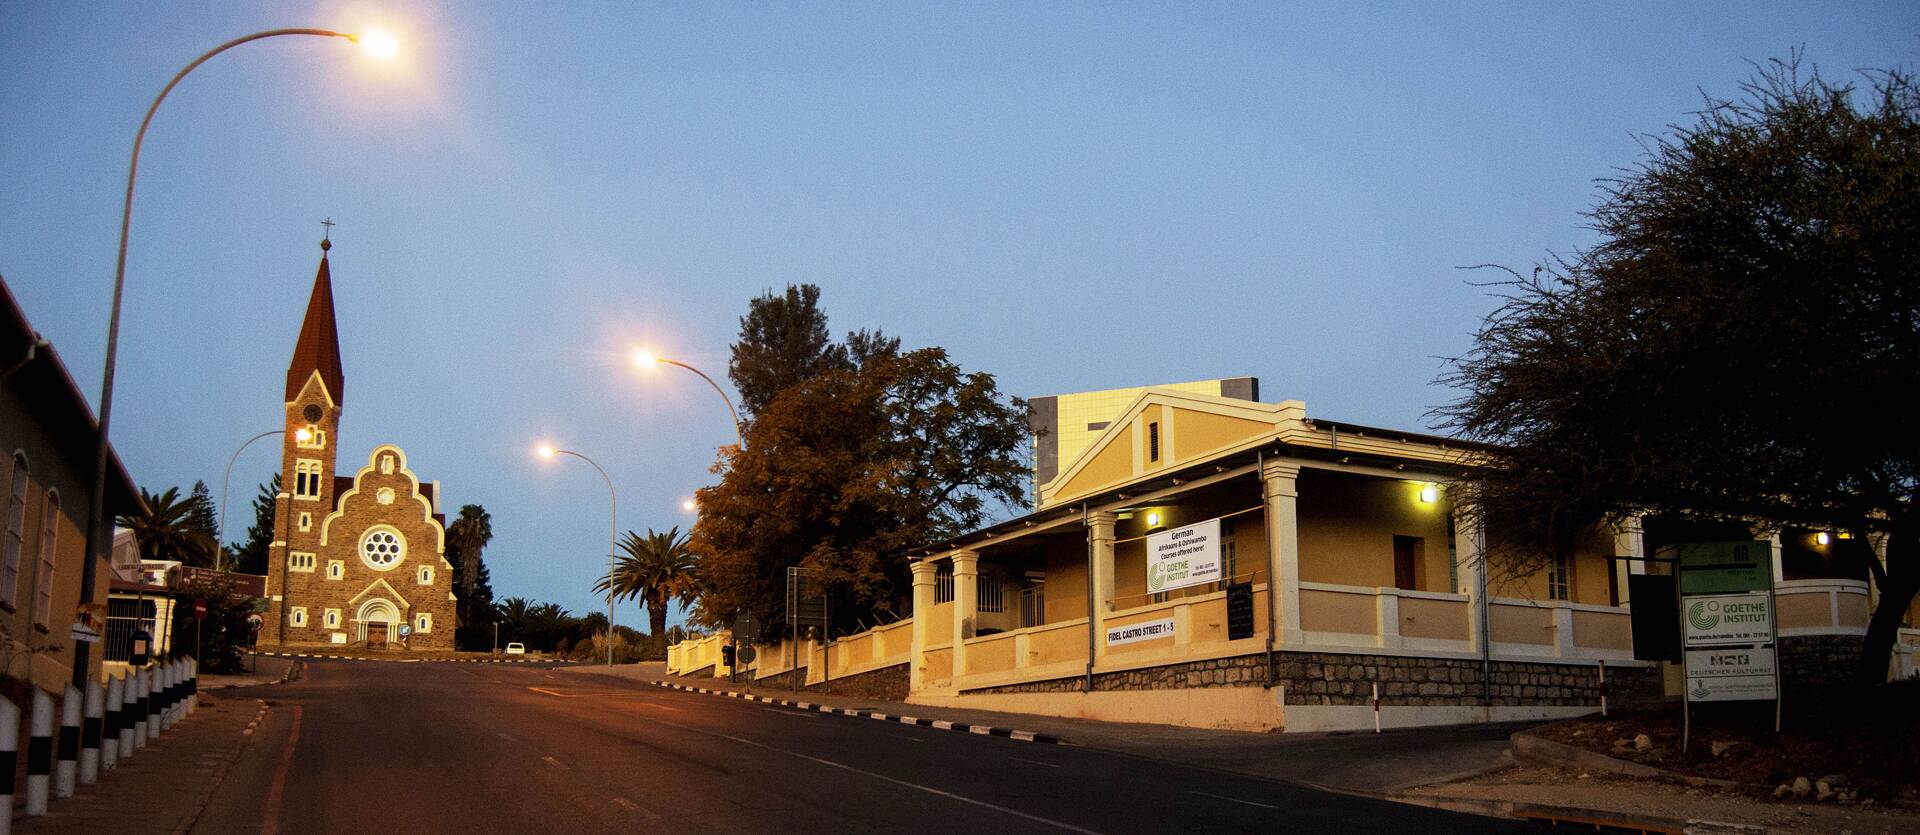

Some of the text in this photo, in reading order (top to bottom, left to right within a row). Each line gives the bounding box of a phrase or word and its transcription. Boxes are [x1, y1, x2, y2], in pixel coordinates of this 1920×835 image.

[1172, 529, 1194, 540] German
[1158, 542, 1178, 552] Afrikaans
[1182, 536, 1206, 546] Oshiwambo
[1161, 552, 1176, 560] Courses
[1178, 547, 1192, 556] offered
[1166, 560, 1188, 572] GOETHE
[1166, 570, 1188, 581] INSTITUT
[1723, 602, 1766, 613] GOETHE
[1724, 614, 1766, 623] INSTITUT
[1108, 632, 1121, 642] FIDEL
[1122, 628, 1142, 639] CASTRO
[1143, 624, 1162, 636] STREET
[1163, 624, 1166, 632] 1
[1170, 622, 1173, 631] 5
